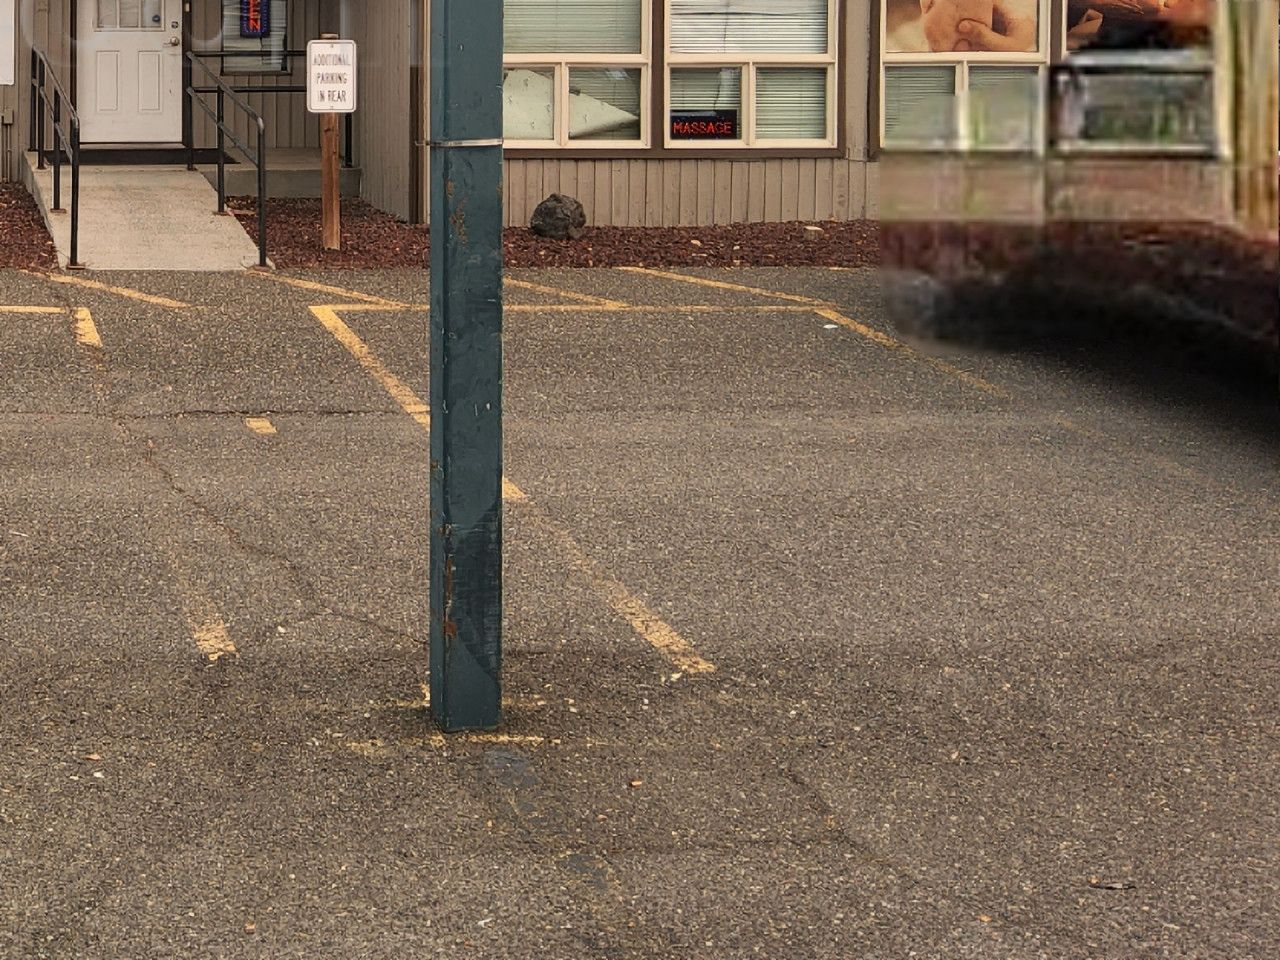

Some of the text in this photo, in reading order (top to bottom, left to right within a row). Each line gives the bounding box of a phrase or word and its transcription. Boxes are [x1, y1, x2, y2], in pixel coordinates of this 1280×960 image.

[312, 53, 351, 66] ADDITIONAL
[317, 72, 348, 85] PARKING
[317, 90, 347, 102] IN REAR
[672, 121, 733, 135] MASSAGE
